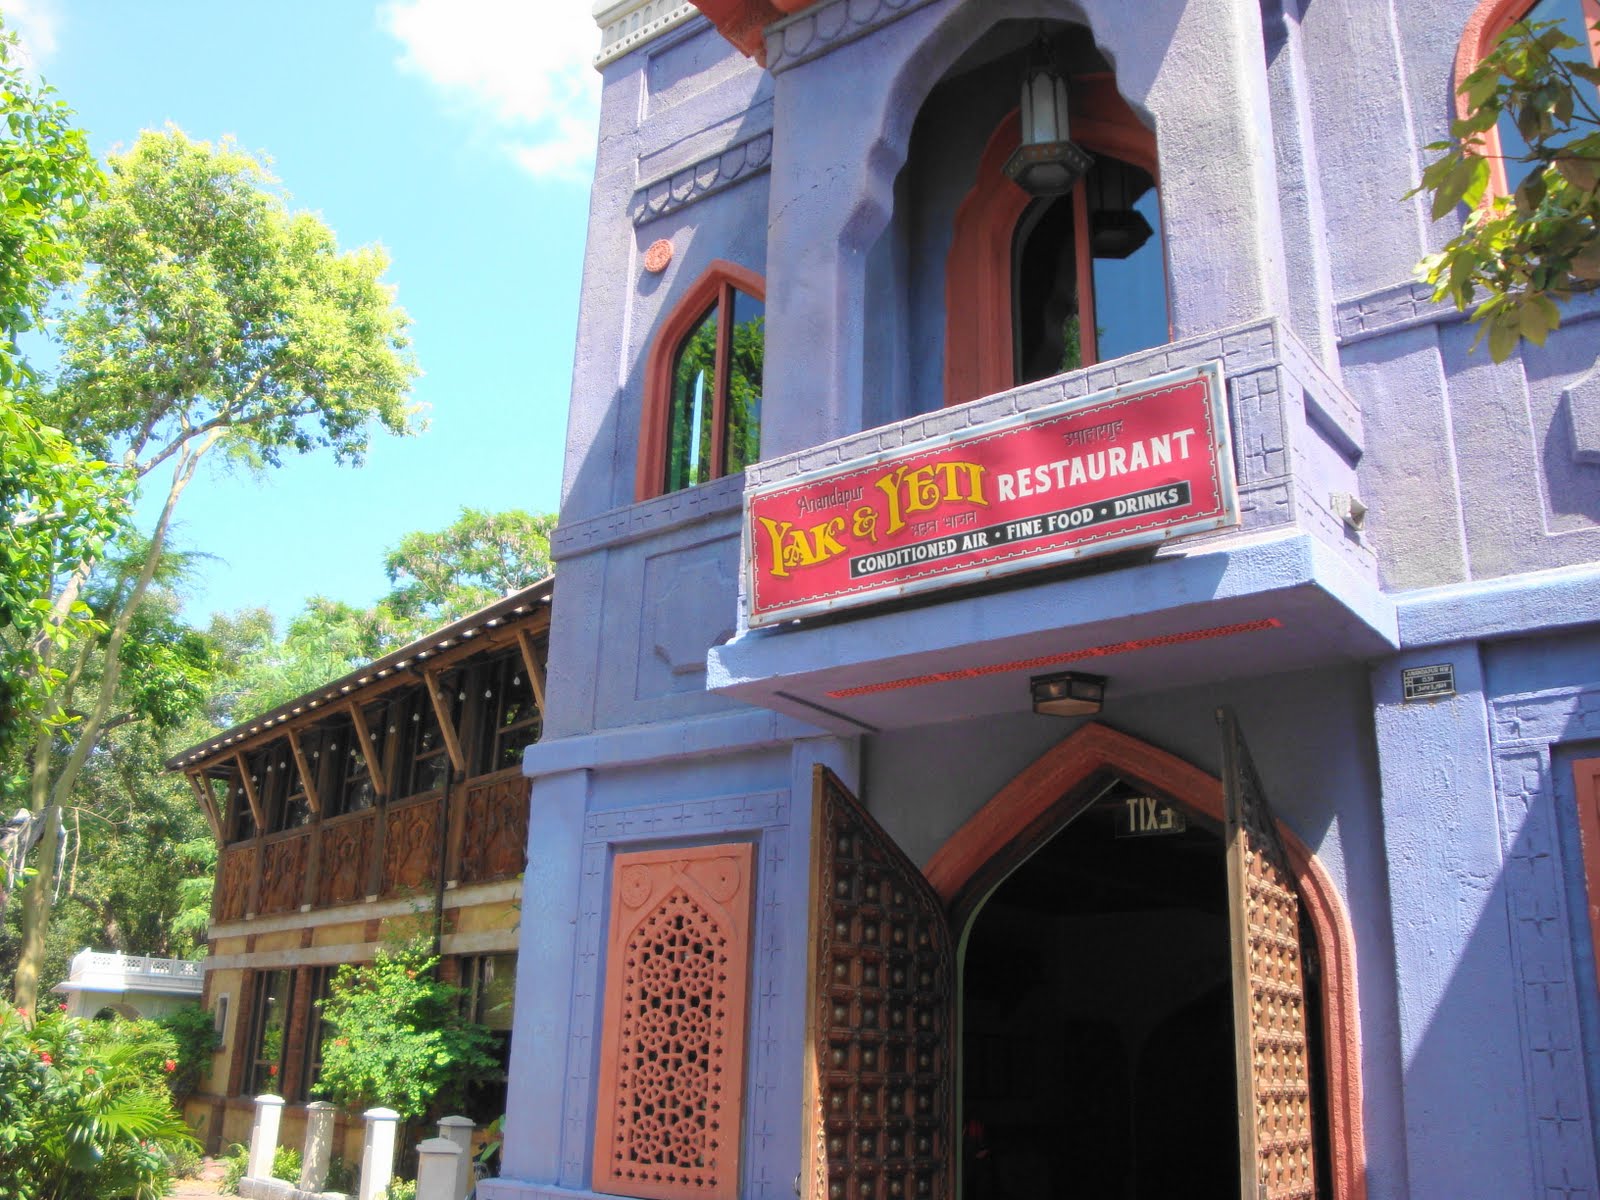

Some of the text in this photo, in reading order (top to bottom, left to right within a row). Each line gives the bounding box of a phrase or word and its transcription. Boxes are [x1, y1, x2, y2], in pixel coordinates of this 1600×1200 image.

[758, 428, 1195, 577] YAK & YETI RESTAURANT
[796, 486, 865, 519] Anandapur
[857, 487, 1180, 574] CONDITIONED AIR FINE FOOD DRINKS
